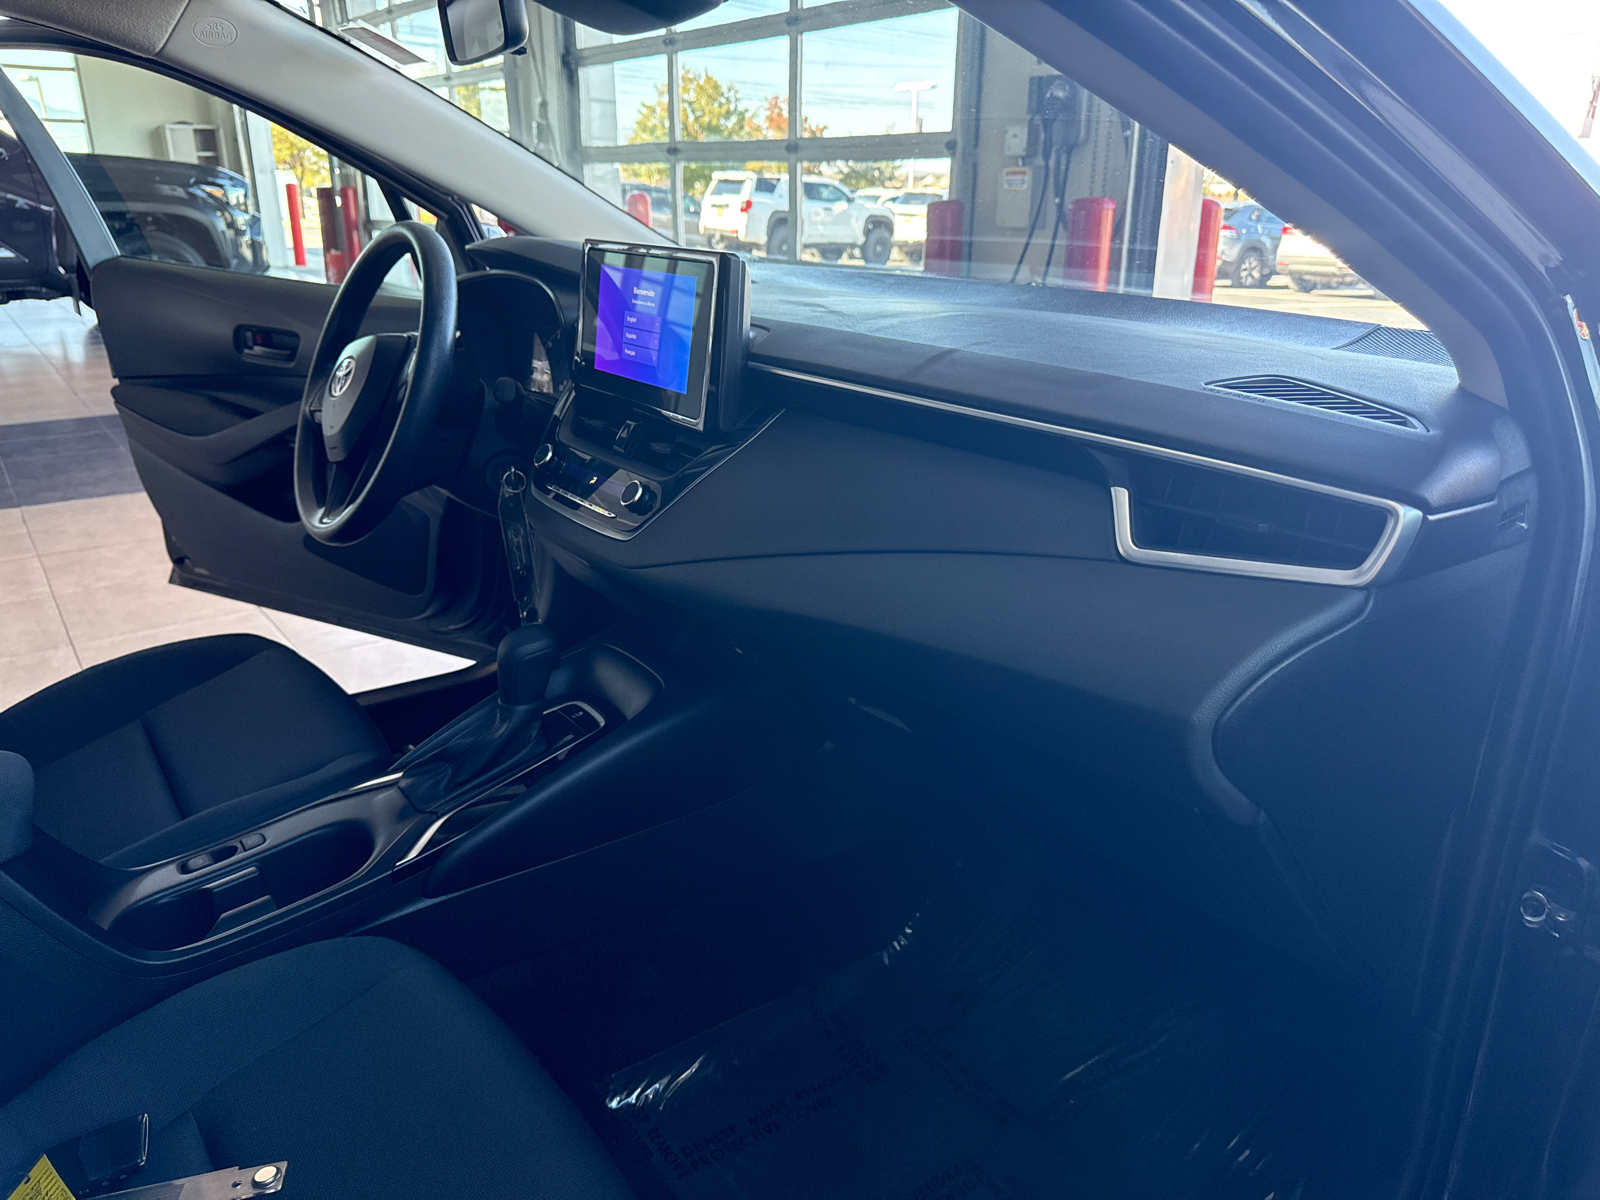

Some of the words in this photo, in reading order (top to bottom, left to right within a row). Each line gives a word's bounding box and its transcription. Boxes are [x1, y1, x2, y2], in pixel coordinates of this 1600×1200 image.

[206, 21, 224, 31] SRS
[199, 30, 233, 41] AIRBAG
[633, 286, 656, 297] Bienvenido
